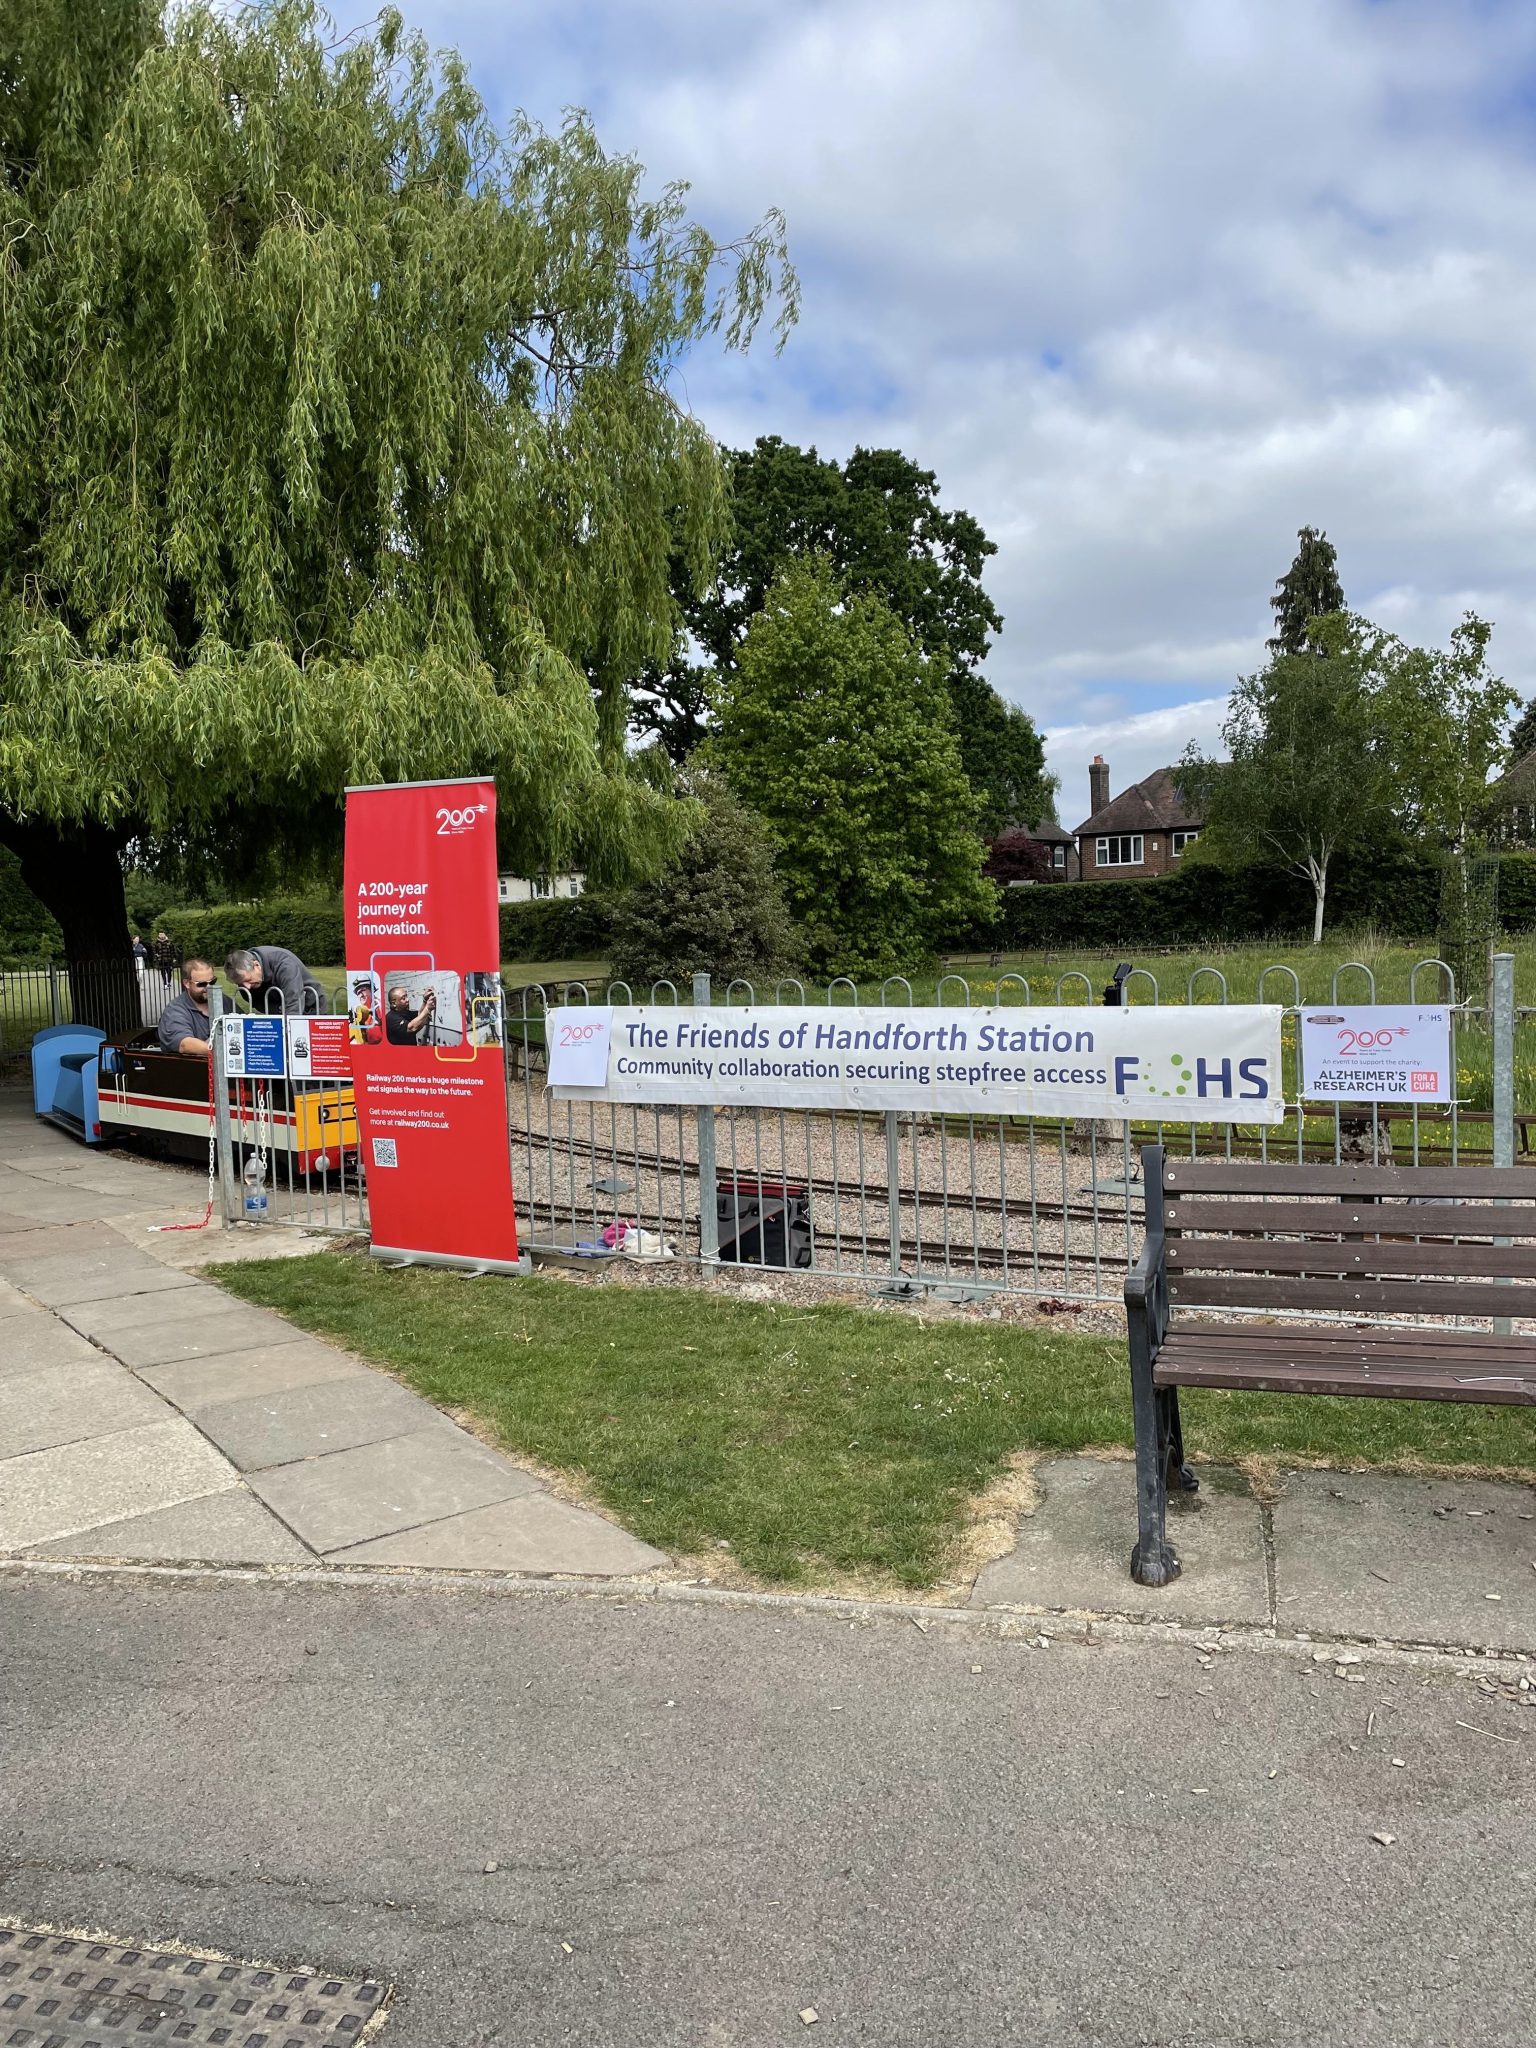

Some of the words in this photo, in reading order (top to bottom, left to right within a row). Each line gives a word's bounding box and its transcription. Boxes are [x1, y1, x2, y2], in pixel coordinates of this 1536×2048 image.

[436, 807, 476, 835] 200
[358, 883, 367, 896] A
[369, 882, 428, 898] 200-year
[357, 902, 406, 919] journey
[409, 901, 423, 915] of
[358, 921, 429, 936] innovation.
[560, 1024, 593, 1047] 200
[625, 1023, 669, 1049] The
[676, 1022, 770, 1049] Friends
[778, 1022, 808, 1049] of
[815, 1023, 967, 1051] Handforth
[977, 1024, 1095, 1053] Station
[1338, 1029, 1393, 1056] 200
[617, 1057, 713, 1080] Community
[718, 1058, 839, 1079] collaboration
[845, 1061, 930, 1085] securing
[936, 1062, 1027, 1087] stepfree
[1033, 1068, 1107, 1084] access
[1319, 1071, 1407, 1081] ALZHEIMER'S
[1413, 1074, 1428, 1082] FOR
[366, 1074, 391, 1083] Railway
[405, 1076, 426, 1084] marks
[432, 1076, 449, 1085] huge
[450, 1077, 484, 1085] milestone
[1413, 1082, 1436, 1090] CURE
[380, 1086, 403, 1094] signals
[404, 1086, 415, 1094] the
[415, 1088, 429, 1096] way
[430, 1087, 438, 1095] to
[438, 1087, 449, 1095] the
[450, 1087, 473, 1096] future.
[1313, 1081, 1385, 1092] RESEARCH
[1388, 1082, 1407, 1092] UK
[381, 1109, 407, 1117] involved
[420, 1110, 433, 1118] find
[394, 1119, 450, 1129] railway200.co.uk
